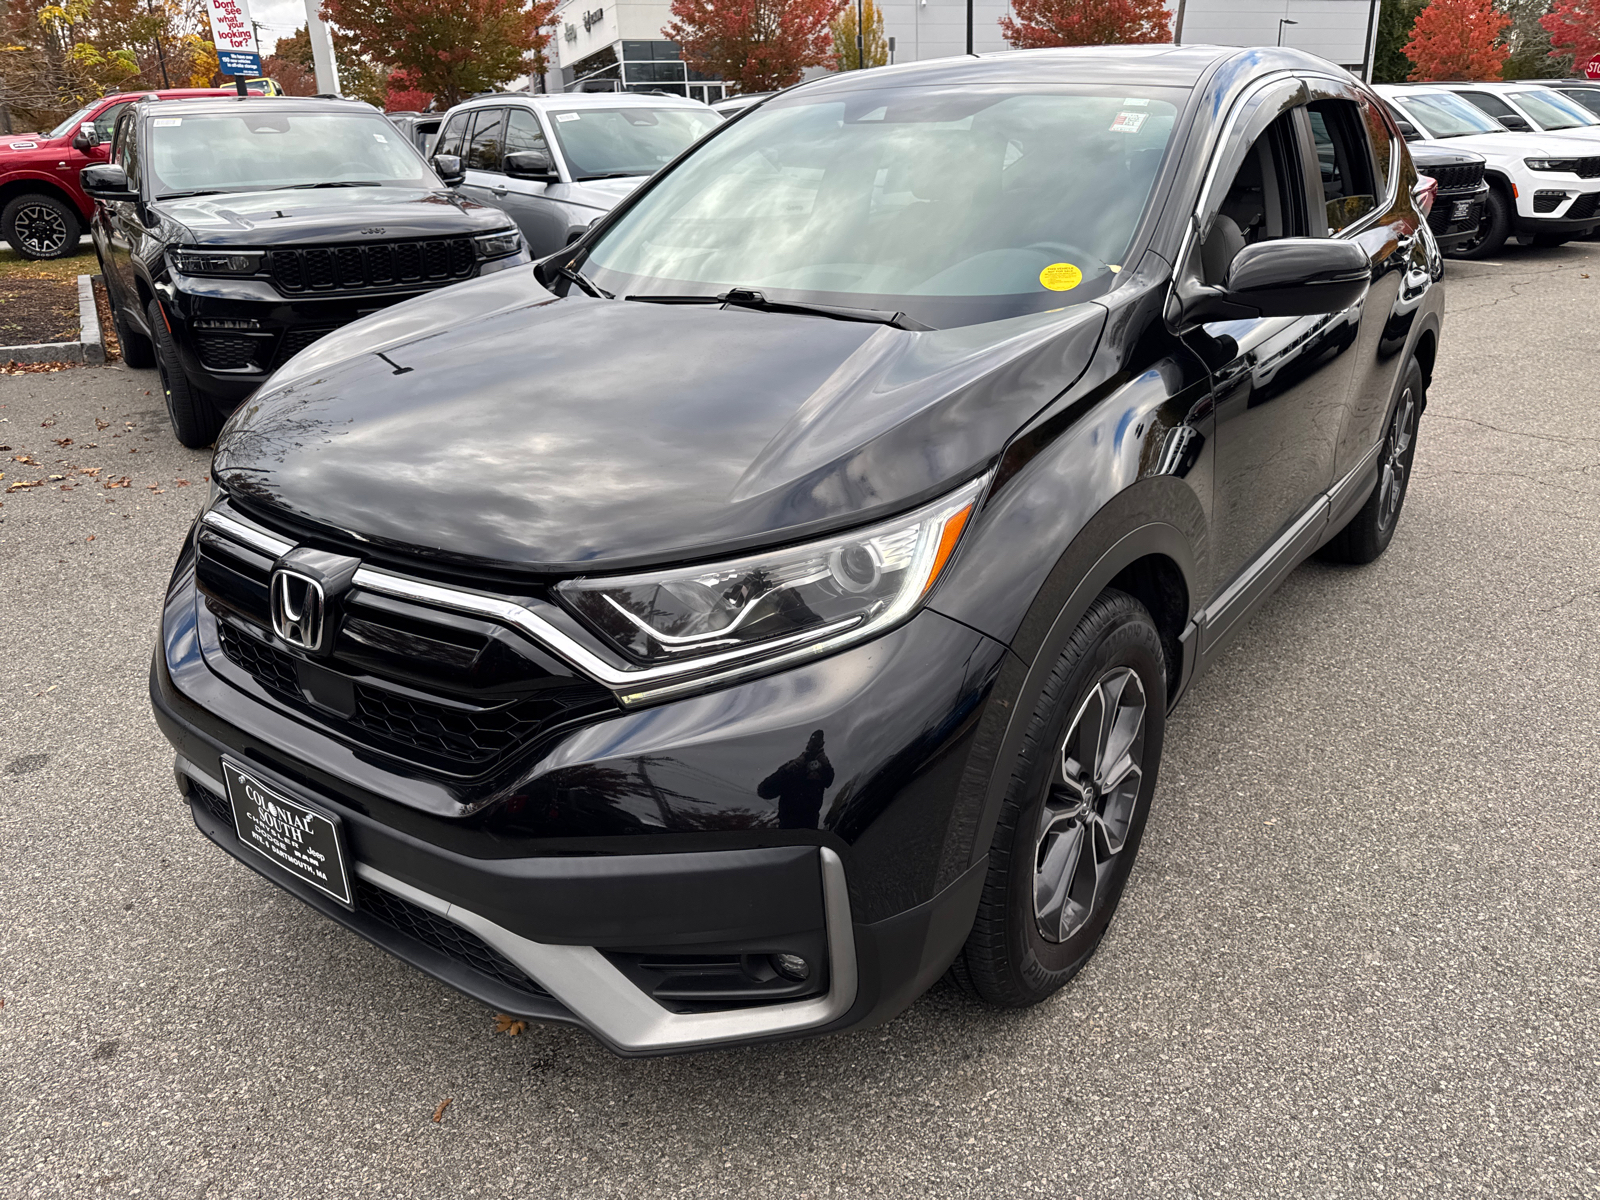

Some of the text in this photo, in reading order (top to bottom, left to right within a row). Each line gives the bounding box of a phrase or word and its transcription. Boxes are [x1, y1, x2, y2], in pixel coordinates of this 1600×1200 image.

[213, 0, 236, 8] Dont
[217, 15, 238, 23] what
[227, 22, 244, 30] your
[218, 30, 252, 39] looking
[230, 38, 248, 48] for?
[361, 227, 386, 235] Jeep
[245, 785, 314, 835] COLONIAL
[258, 807, 304, 843] SOUTH
[246, 812, 326, 862] CHRYSLER Jeep
[254, 825, 320, 867] DODGE RAM
[271, 846, 315, 876] DARTMOUTH,
[316, 869, 328, 881] MA
